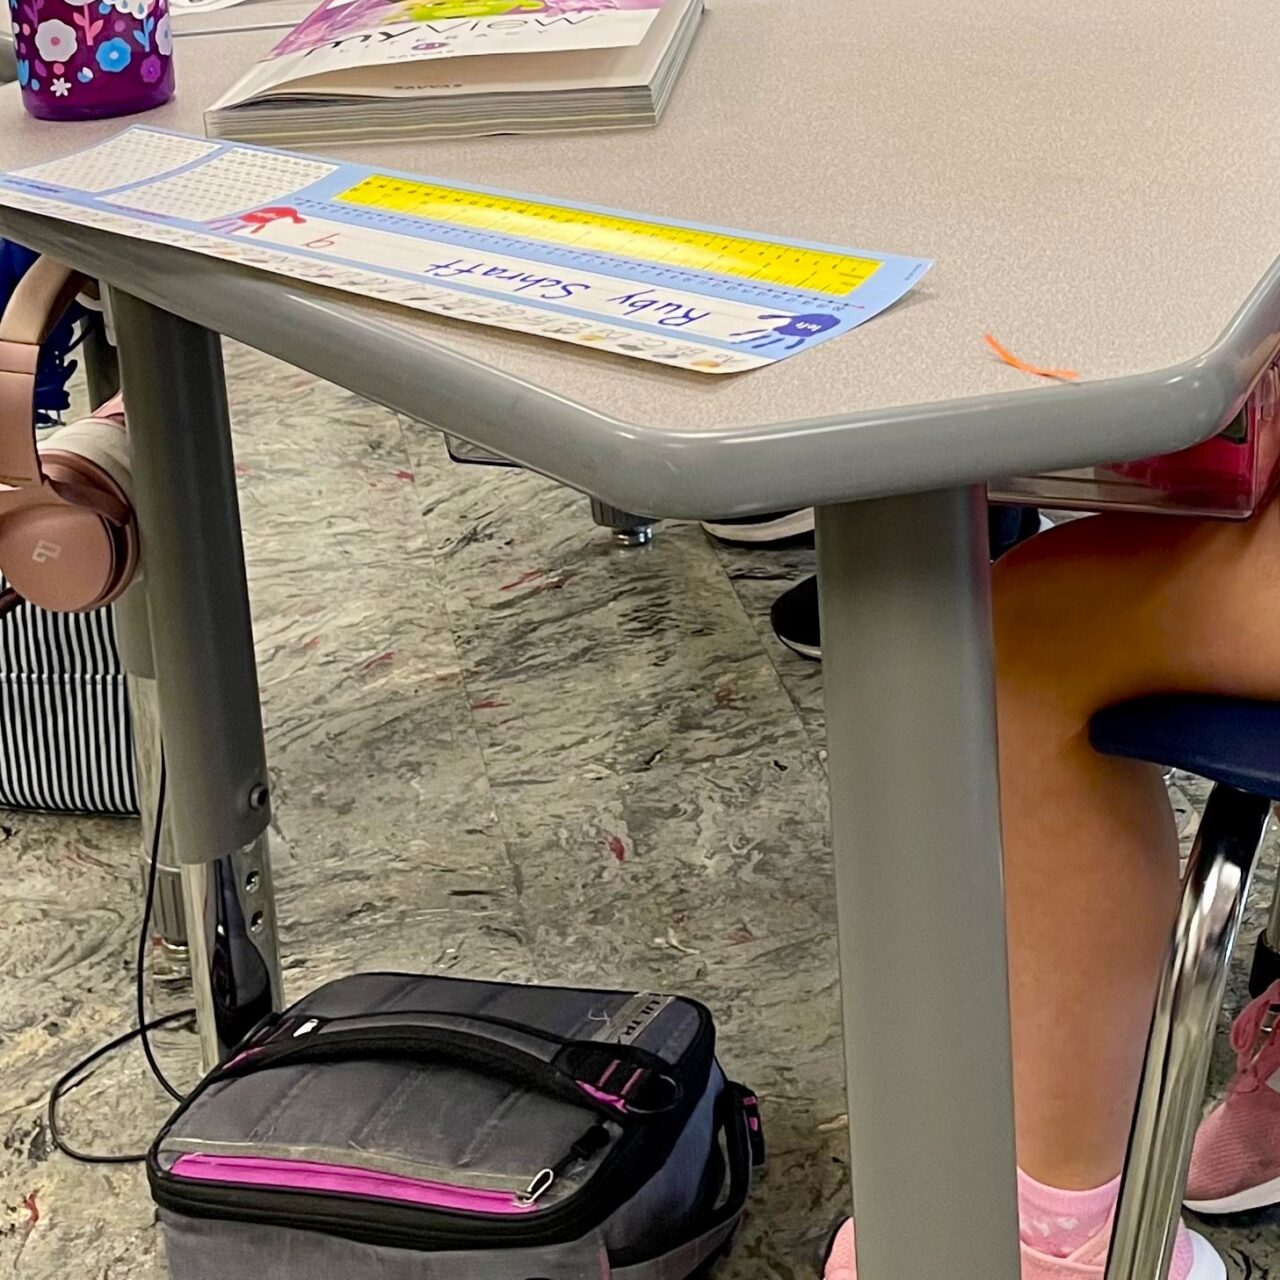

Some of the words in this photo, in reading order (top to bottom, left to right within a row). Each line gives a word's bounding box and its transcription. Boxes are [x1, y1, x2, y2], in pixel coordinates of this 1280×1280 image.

[422, 258, 591, 300] Schraft
[607, 289, 711, 326] Ruby
[618, 999, 661, 1038] ULTR
